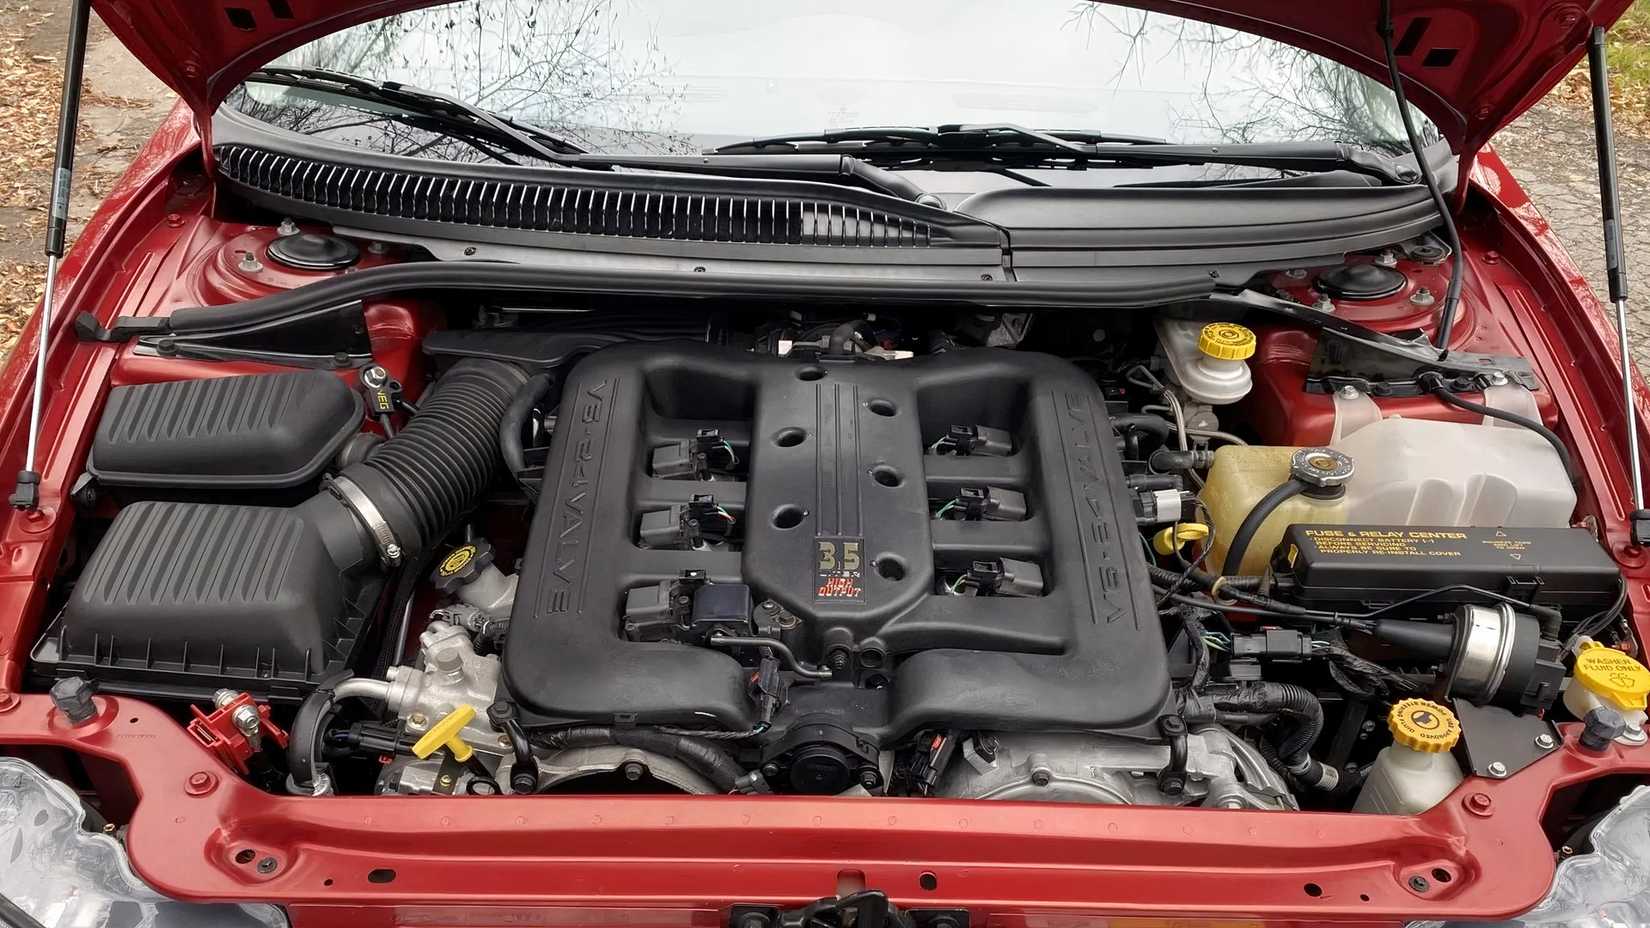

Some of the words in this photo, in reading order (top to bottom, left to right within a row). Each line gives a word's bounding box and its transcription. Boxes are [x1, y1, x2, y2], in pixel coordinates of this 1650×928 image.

[377, 389, 390, 410] NEG
[826, 578, 854, 588] HIGH
[817, 586, 862, 597] OUTPUT
[1615, 664, 1642, 672] ONLY
